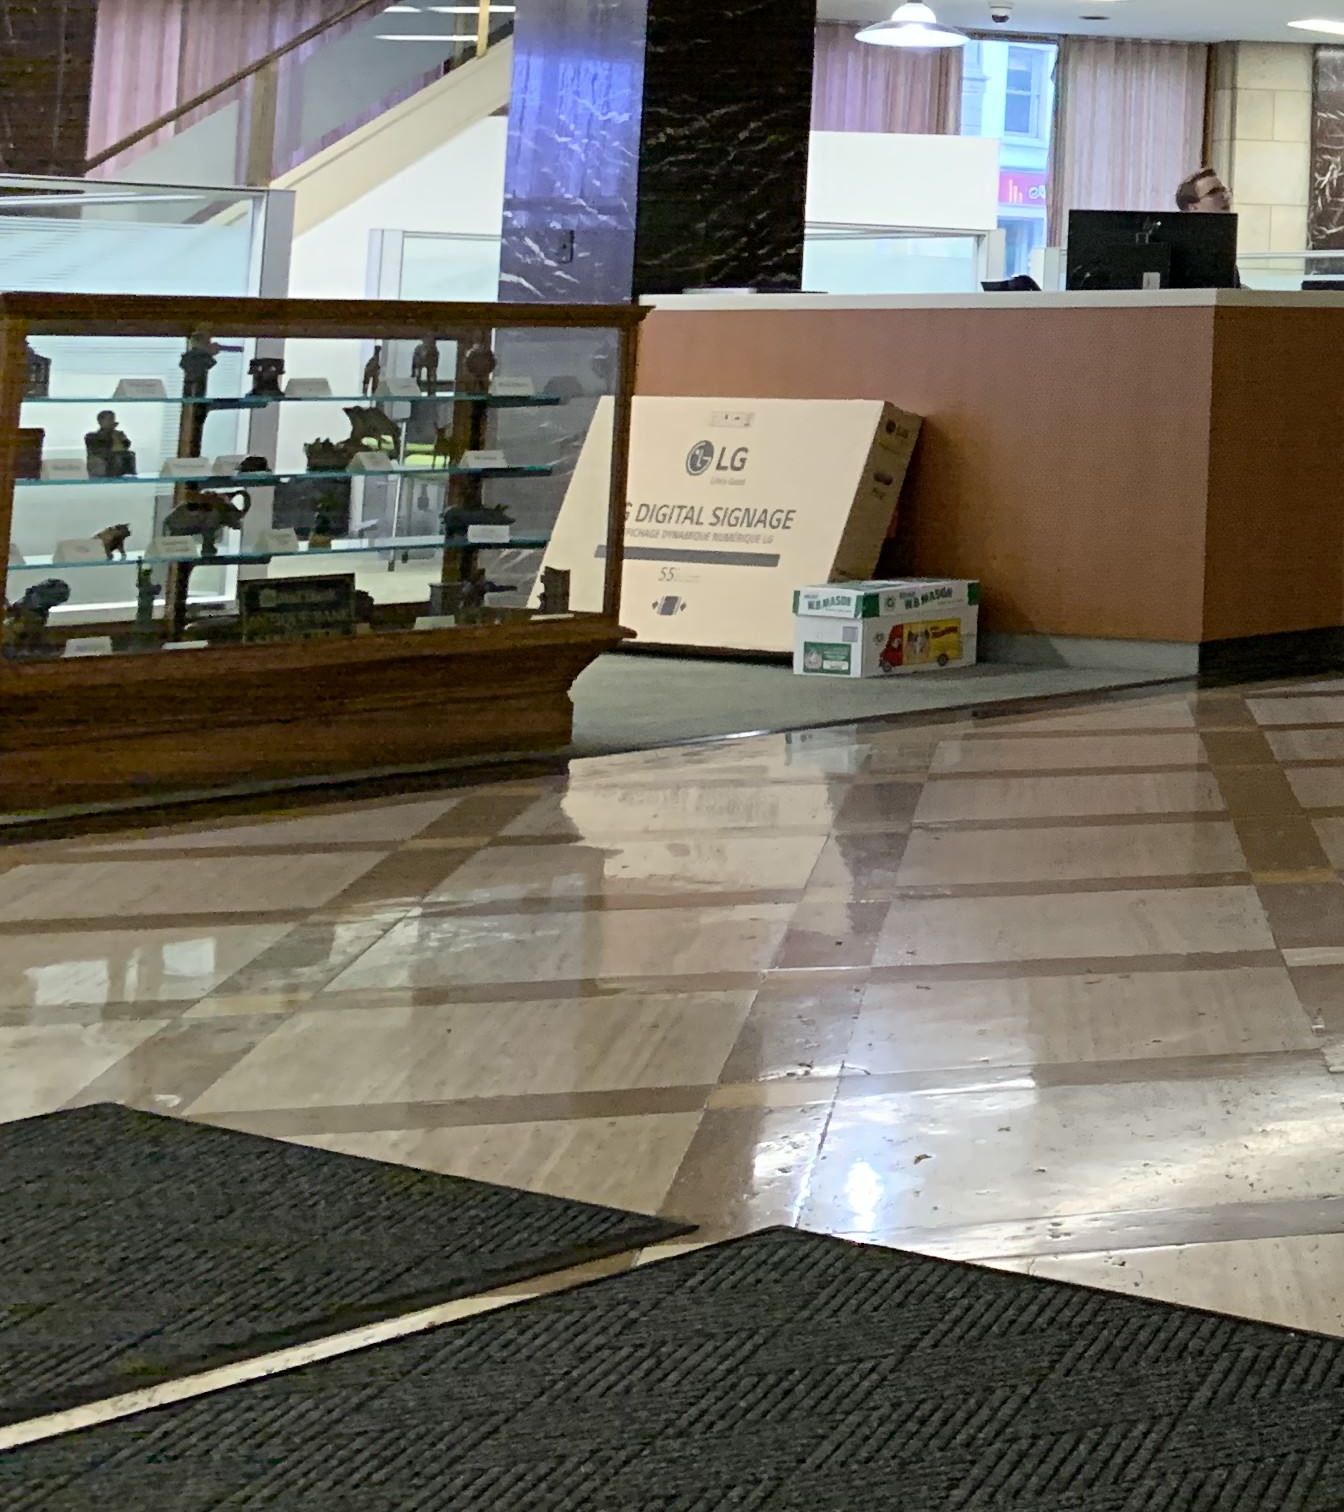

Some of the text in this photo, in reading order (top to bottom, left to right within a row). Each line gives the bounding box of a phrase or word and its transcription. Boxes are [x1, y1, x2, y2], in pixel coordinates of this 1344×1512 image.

[715, 446, 749, 472] LG
[635, 503, 704, 526] DIGITAL
[708, 506, 797, 530] SIGNAGE
